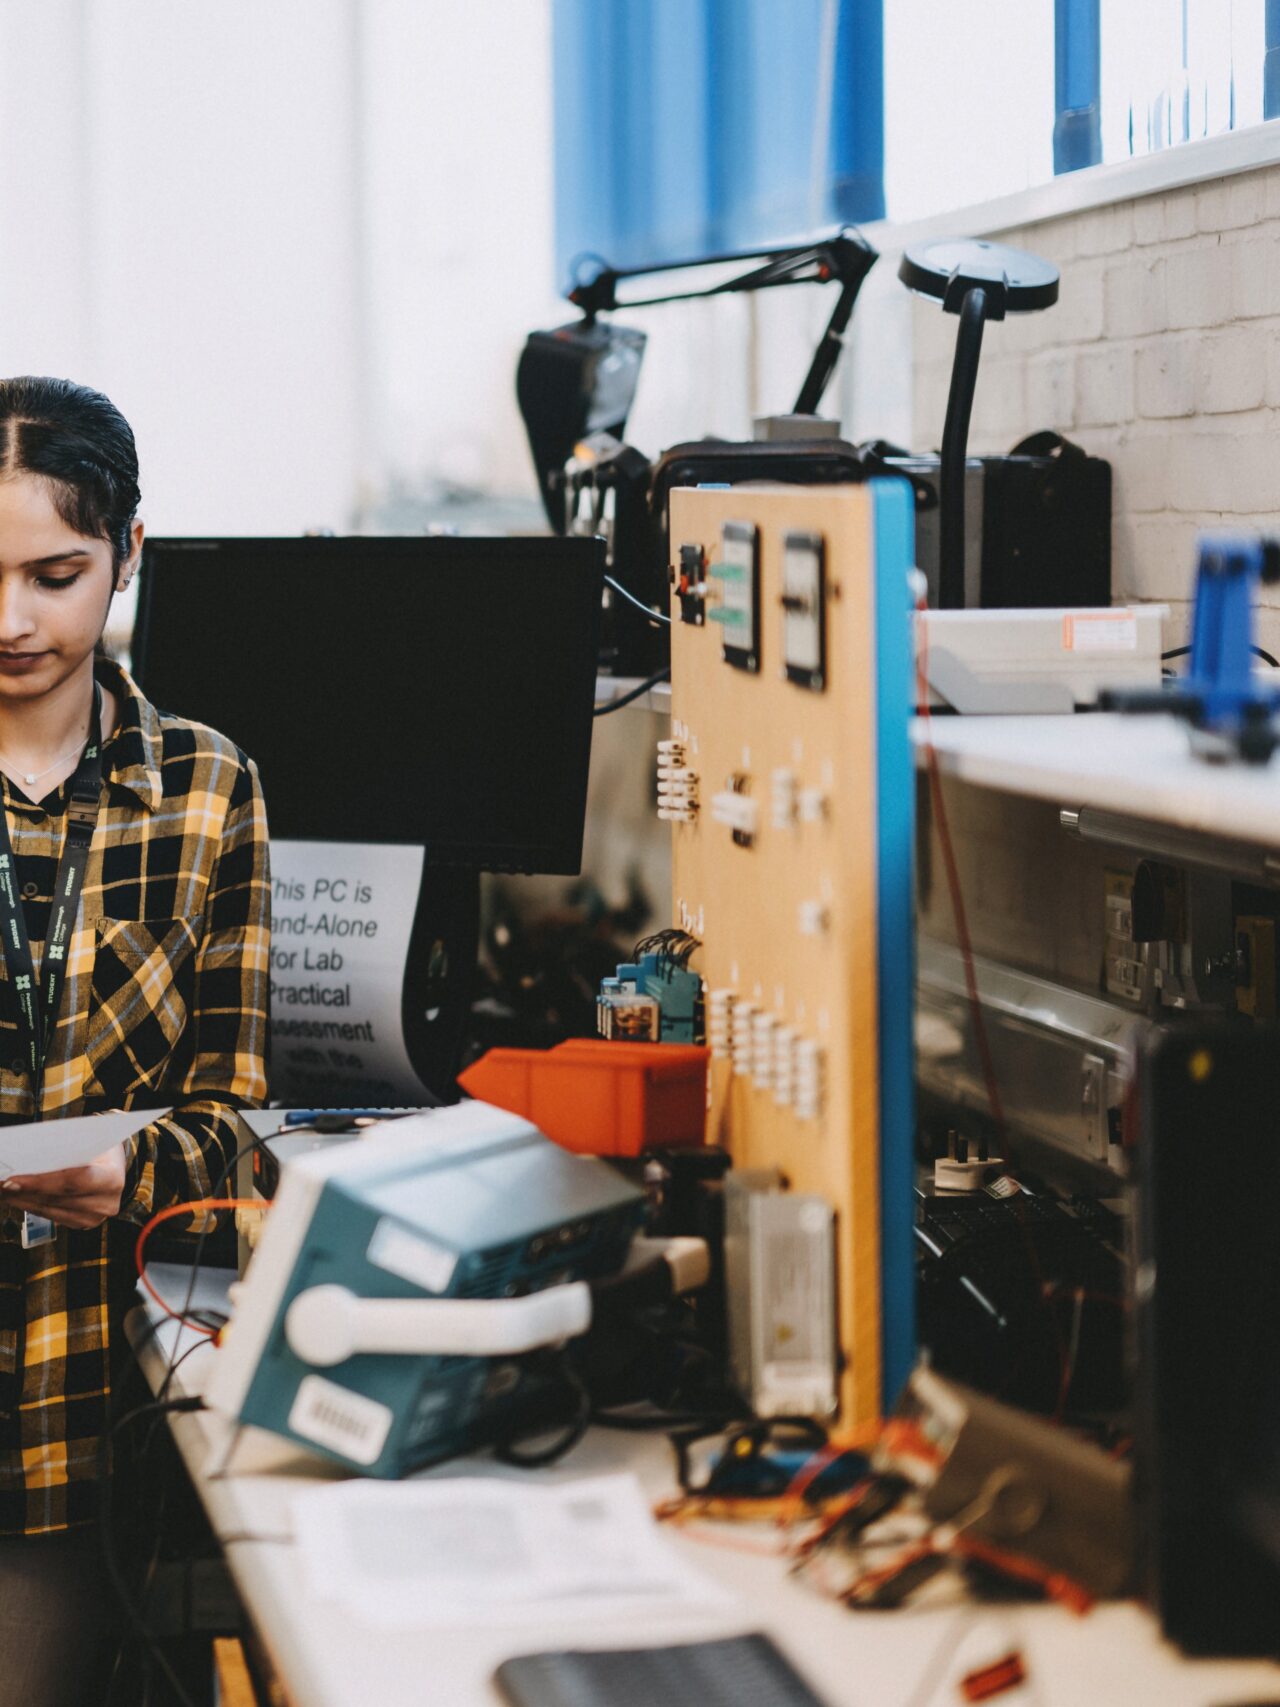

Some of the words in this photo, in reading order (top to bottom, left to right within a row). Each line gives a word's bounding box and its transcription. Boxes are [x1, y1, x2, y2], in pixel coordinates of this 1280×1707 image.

[0, 872, 7, 892] College
[4, 871, 16, 908] Peterborough
[64, 867, 76, 896] STUDENT
[271, 877, 305, 901] his
[313, 878, 348, 902] PC
[354, 881, 372, 904] is
[9, 919, 21, 949] STUDENT
[52, 905, 64, 942] Peterborough
[58, 923, 67, 942] College
[271, 912, 378, 938] and-Alone
[271, 946, 297, 970] for
[304, 947, 344, 971] Lab
[48, 973, 56, 1004] STUDENT
[271, 1019, 375, 1043] ssessment
